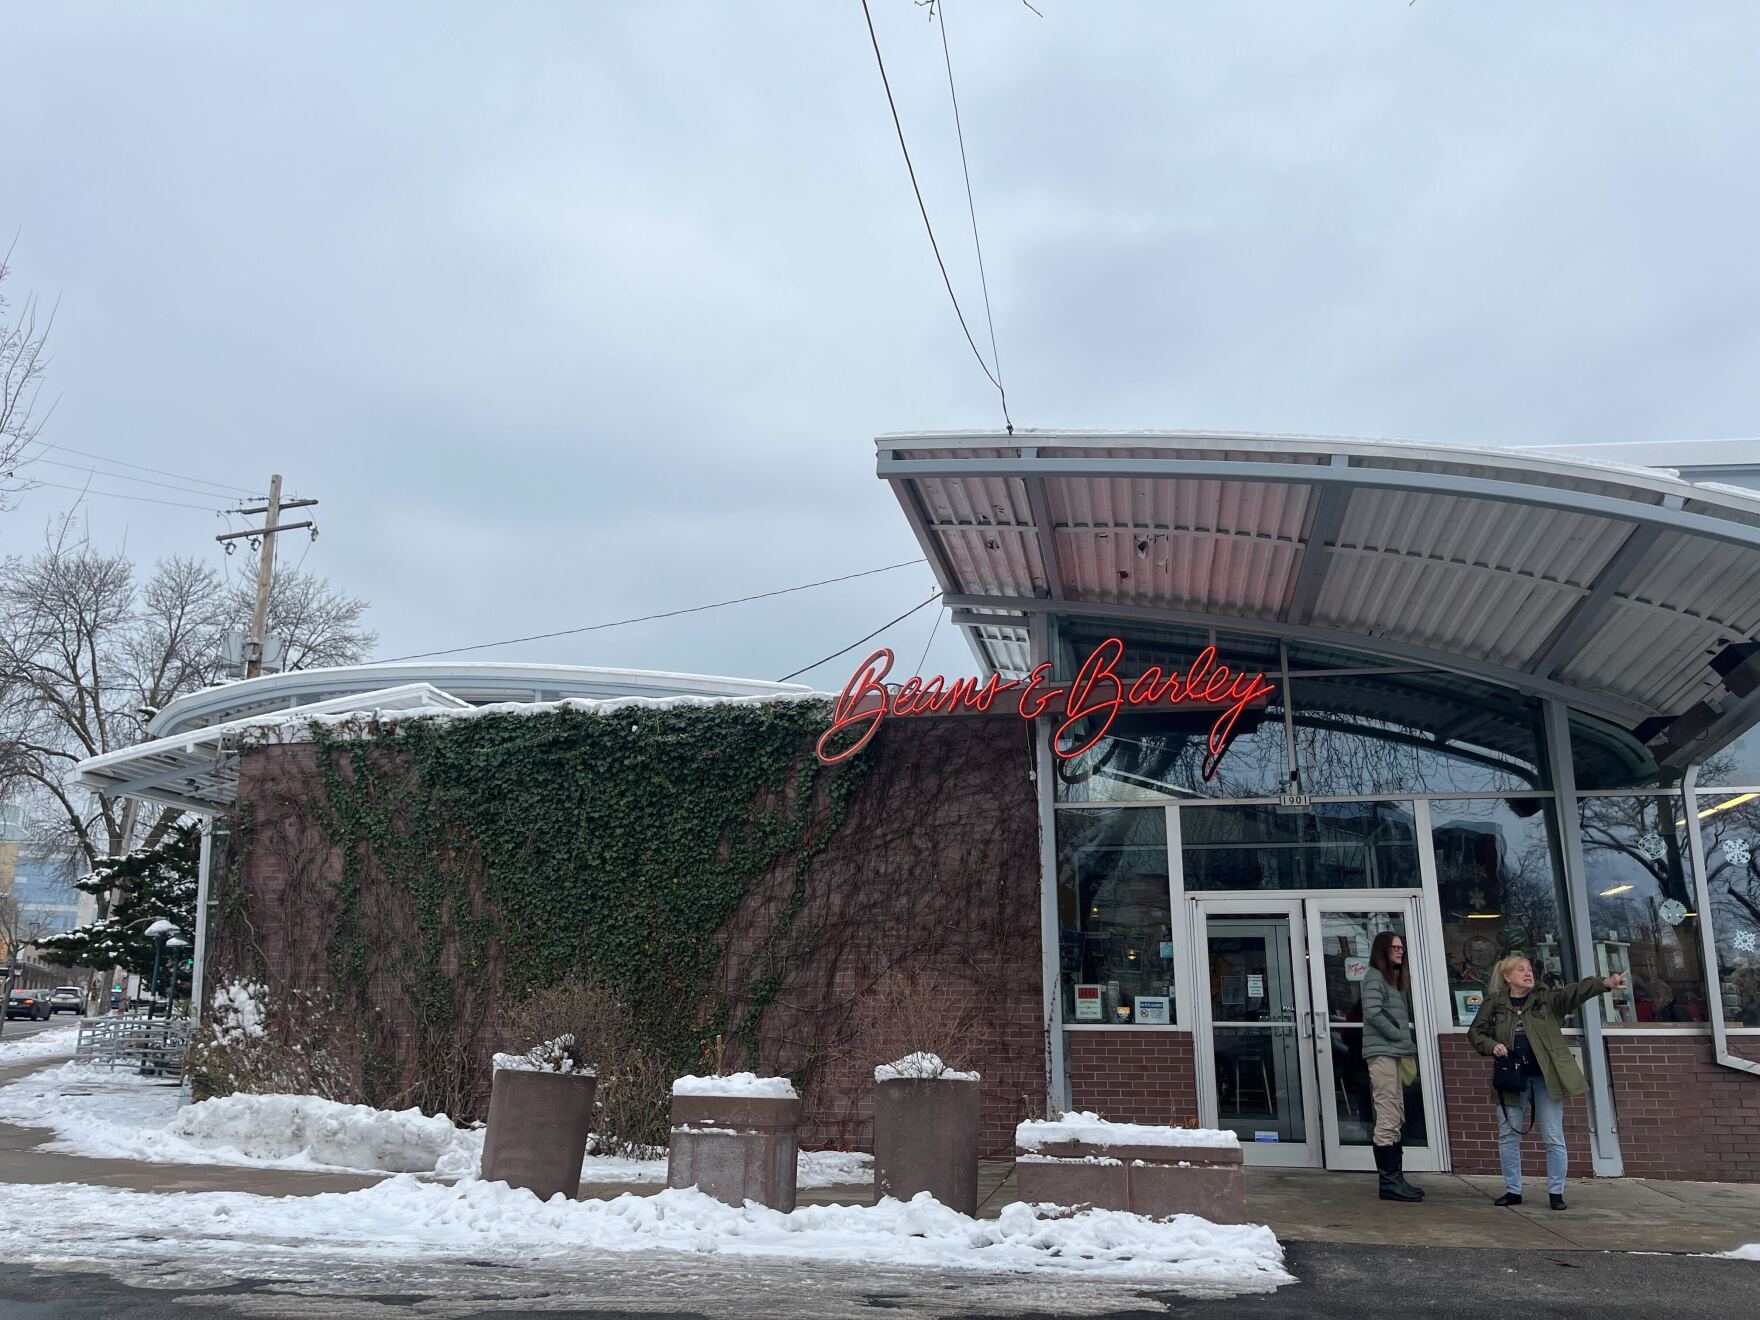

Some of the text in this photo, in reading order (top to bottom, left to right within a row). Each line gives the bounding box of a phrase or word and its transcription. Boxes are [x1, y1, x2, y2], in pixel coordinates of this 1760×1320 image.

[817, 637, 1275, 763] Beans & Barley
[1283, 796, 1307, 804] 1901
